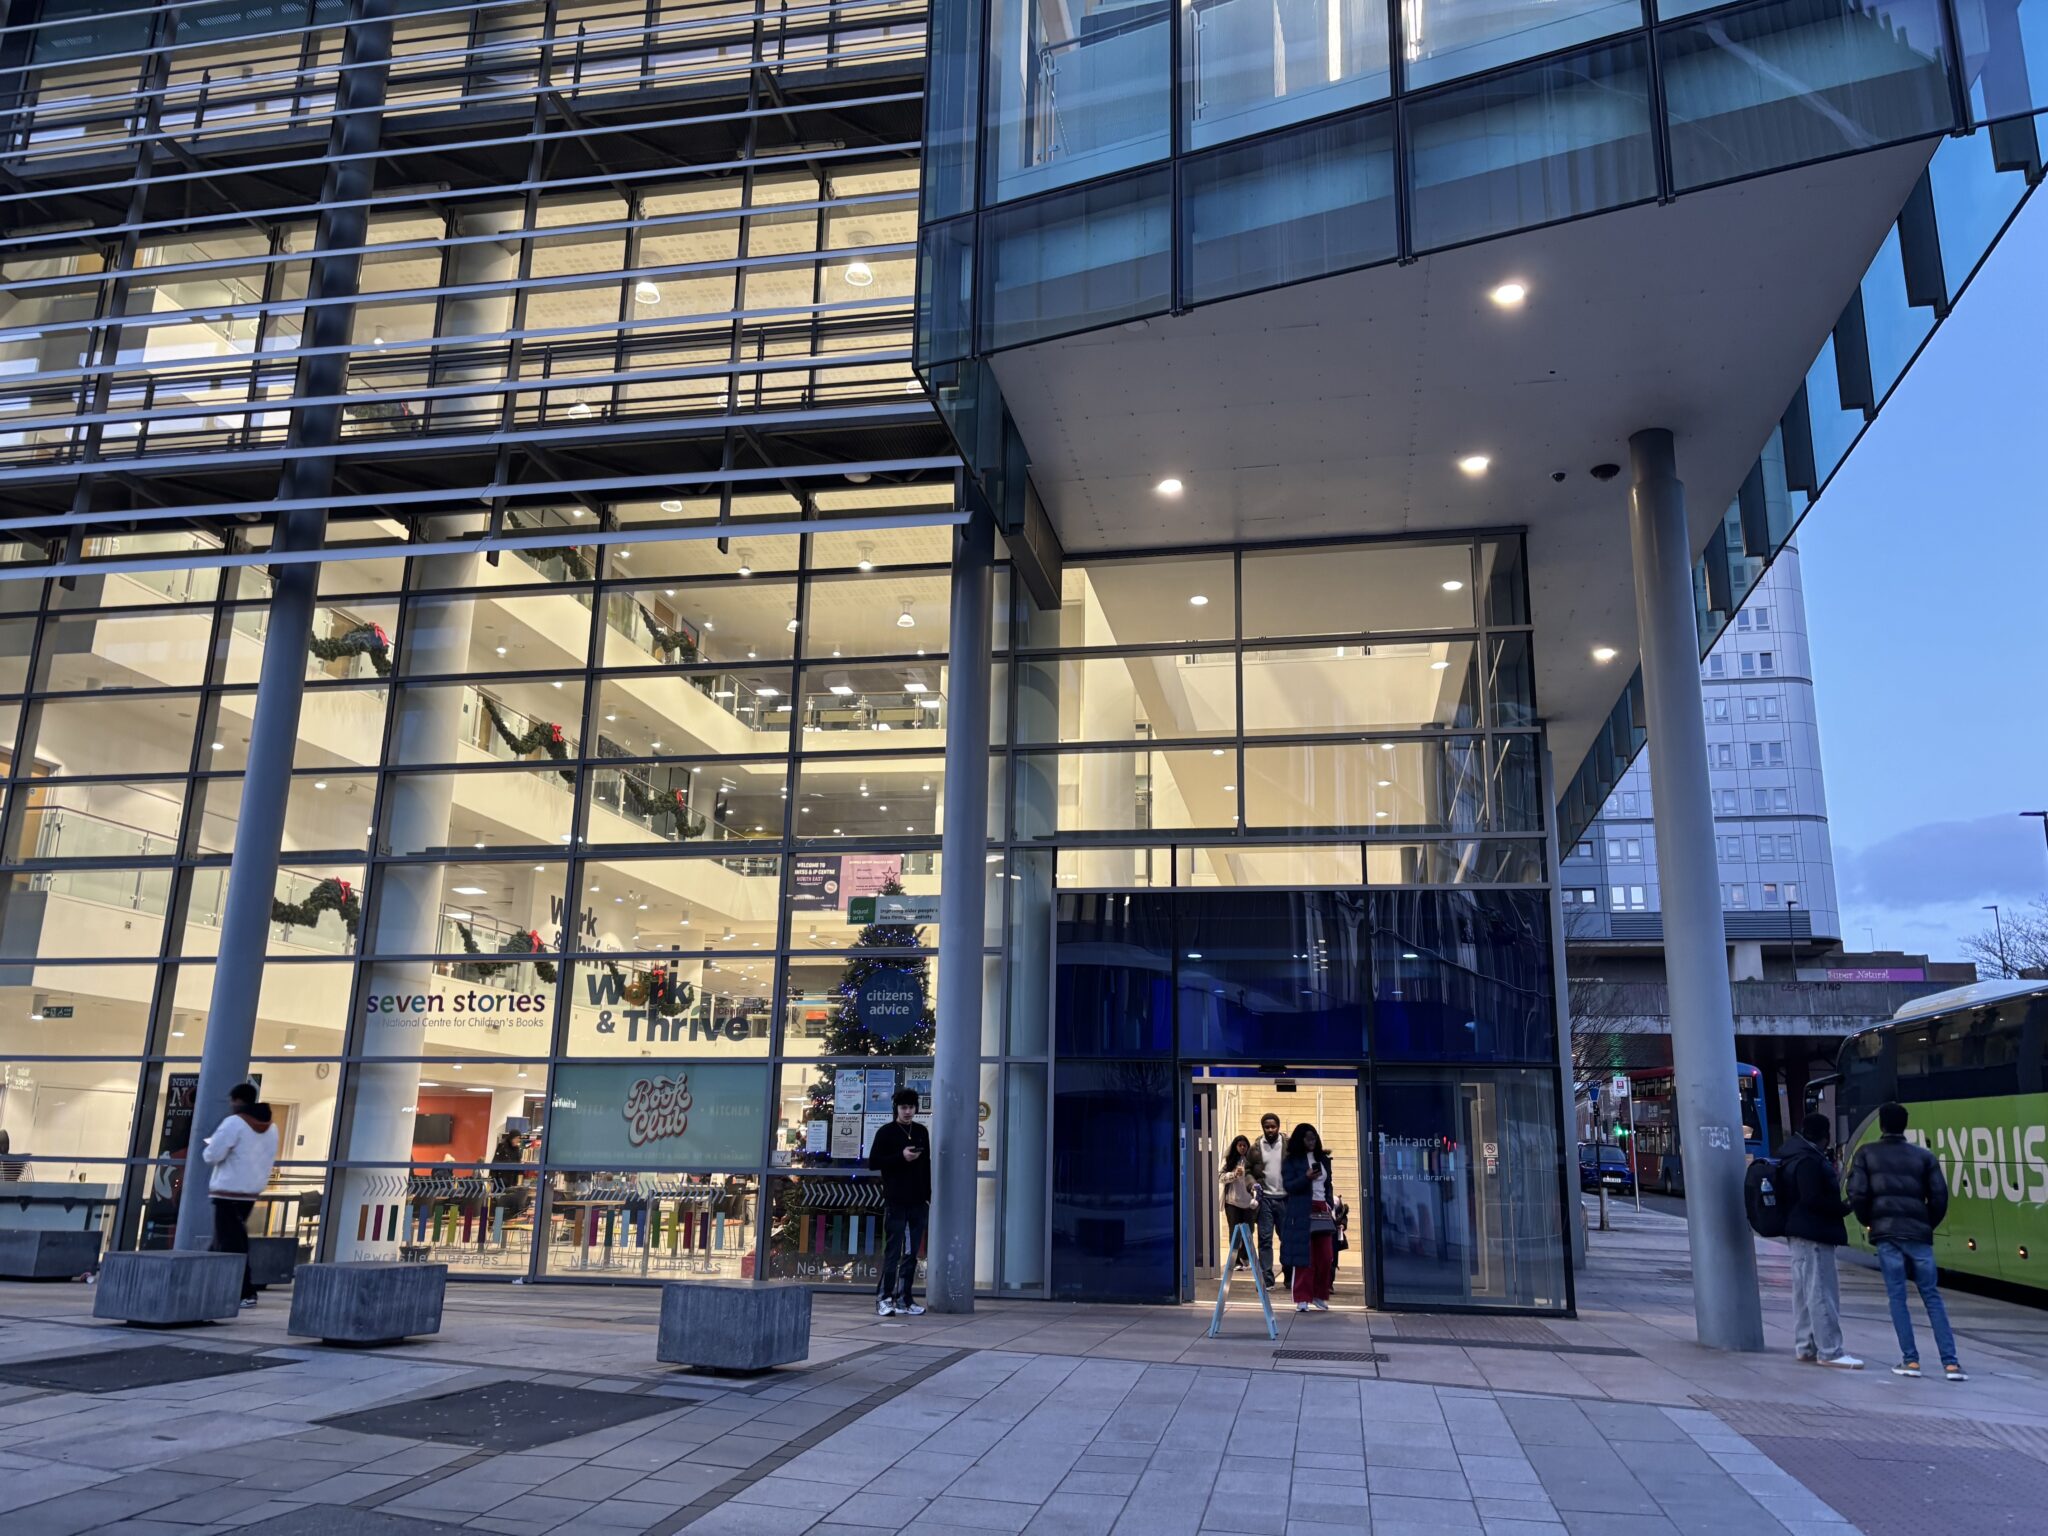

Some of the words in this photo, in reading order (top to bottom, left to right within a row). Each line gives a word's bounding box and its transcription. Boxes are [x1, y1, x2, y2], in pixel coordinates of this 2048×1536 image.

[551, 895, 597, 937] Wrk
[1827, 970, 1854, 980] Super
[1856, 969, 1889, 979] Natural
[367, 994, 444, 1013] seven
[453, 989, 545, 1013] stories
[866, 989, 914, 1001] citizens
[869, 1003, 909, 1015] advice
[382, 1017, 419, 1028] National
[422, 1017, 451, 1028] Centre
[454, 1017, 466, 1028] for
[468, 1017, 514, 1028] Children's
[516, 1017, 544, 1028] Books
[596, 1010, 615, 1034] &
[622, 1007, 749, 1042] Thrive
[622, 1072, 692, 1118] Book
[709, 1105, 750, 1117] KITCHEN
[629, 1106, 688, 1146] Club
[1384, 1134, 1441, 1148] Entrance
[1418, 1172, 1455, 1181] Libraries
